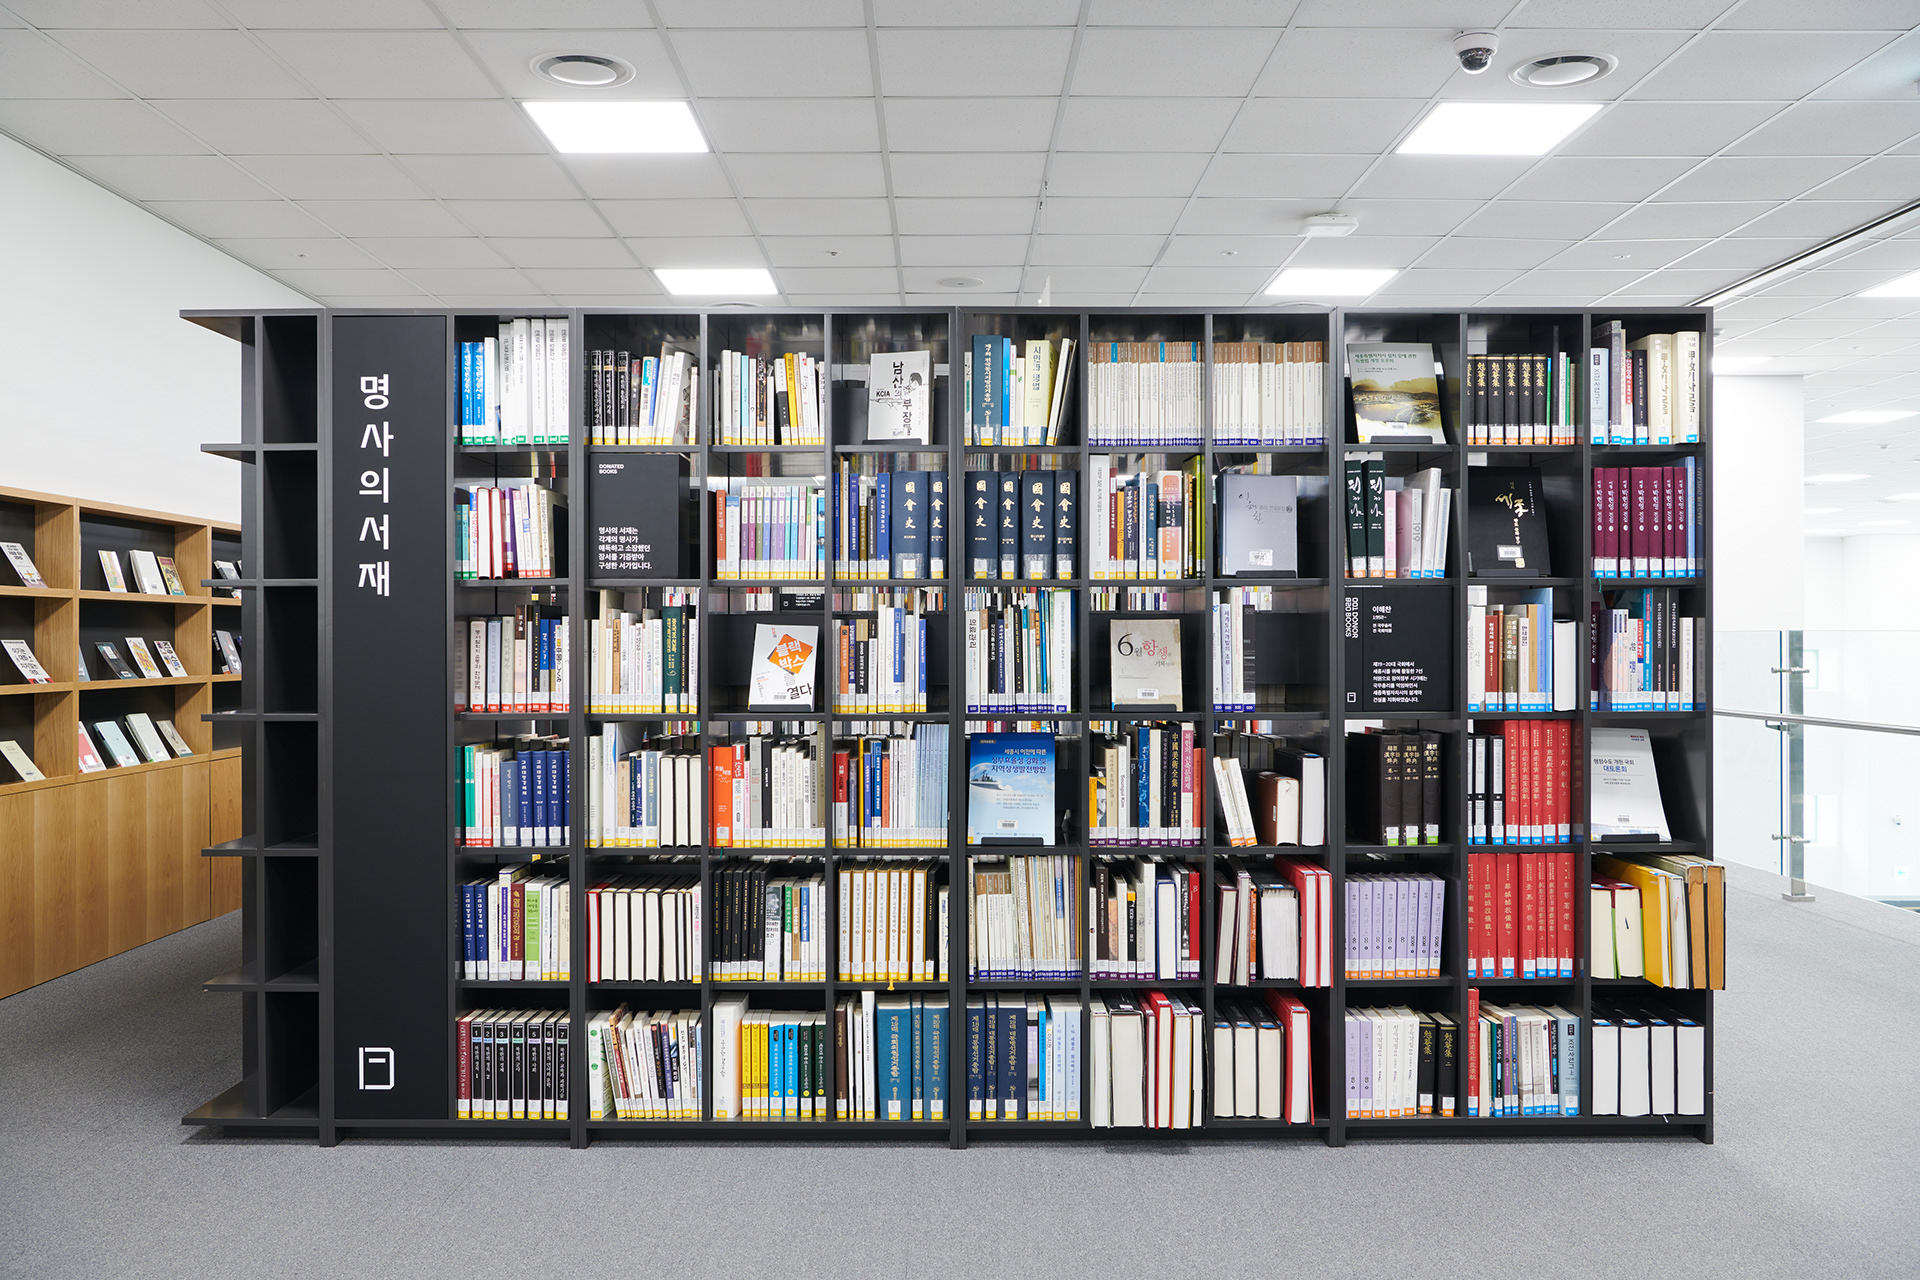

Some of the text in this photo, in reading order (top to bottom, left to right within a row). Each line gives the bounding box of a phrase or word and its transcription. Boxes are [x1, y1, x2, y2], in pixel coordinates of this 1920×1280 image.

[904, 481, 917, 529] 國會史
[931, 481, 944, 529] 國會史
[975, 480, 988, 527] 國會史
[1002, 481, 1015, 528] 國會史
[1030, 482, 1045, 530] 國會史
[1058, 481, 1073, 529] 國會史
[599, 527, 639, 535] 명사의 서재는
[599, 535, 639, 543] 각계의 명사가
[599, 544, 651, 552] 애독하고 소장했던
[599, 553, 645, 561] 장서를 기증받아
[599, 561, 653, 570] 구성한 서가입니다.
[1372, 605, 1392, 613] 이해찬
[776, 640, 802, 658] 블랙
[779, 655, 805, 670] 박스
[787, 683, 812, 700] 열다
